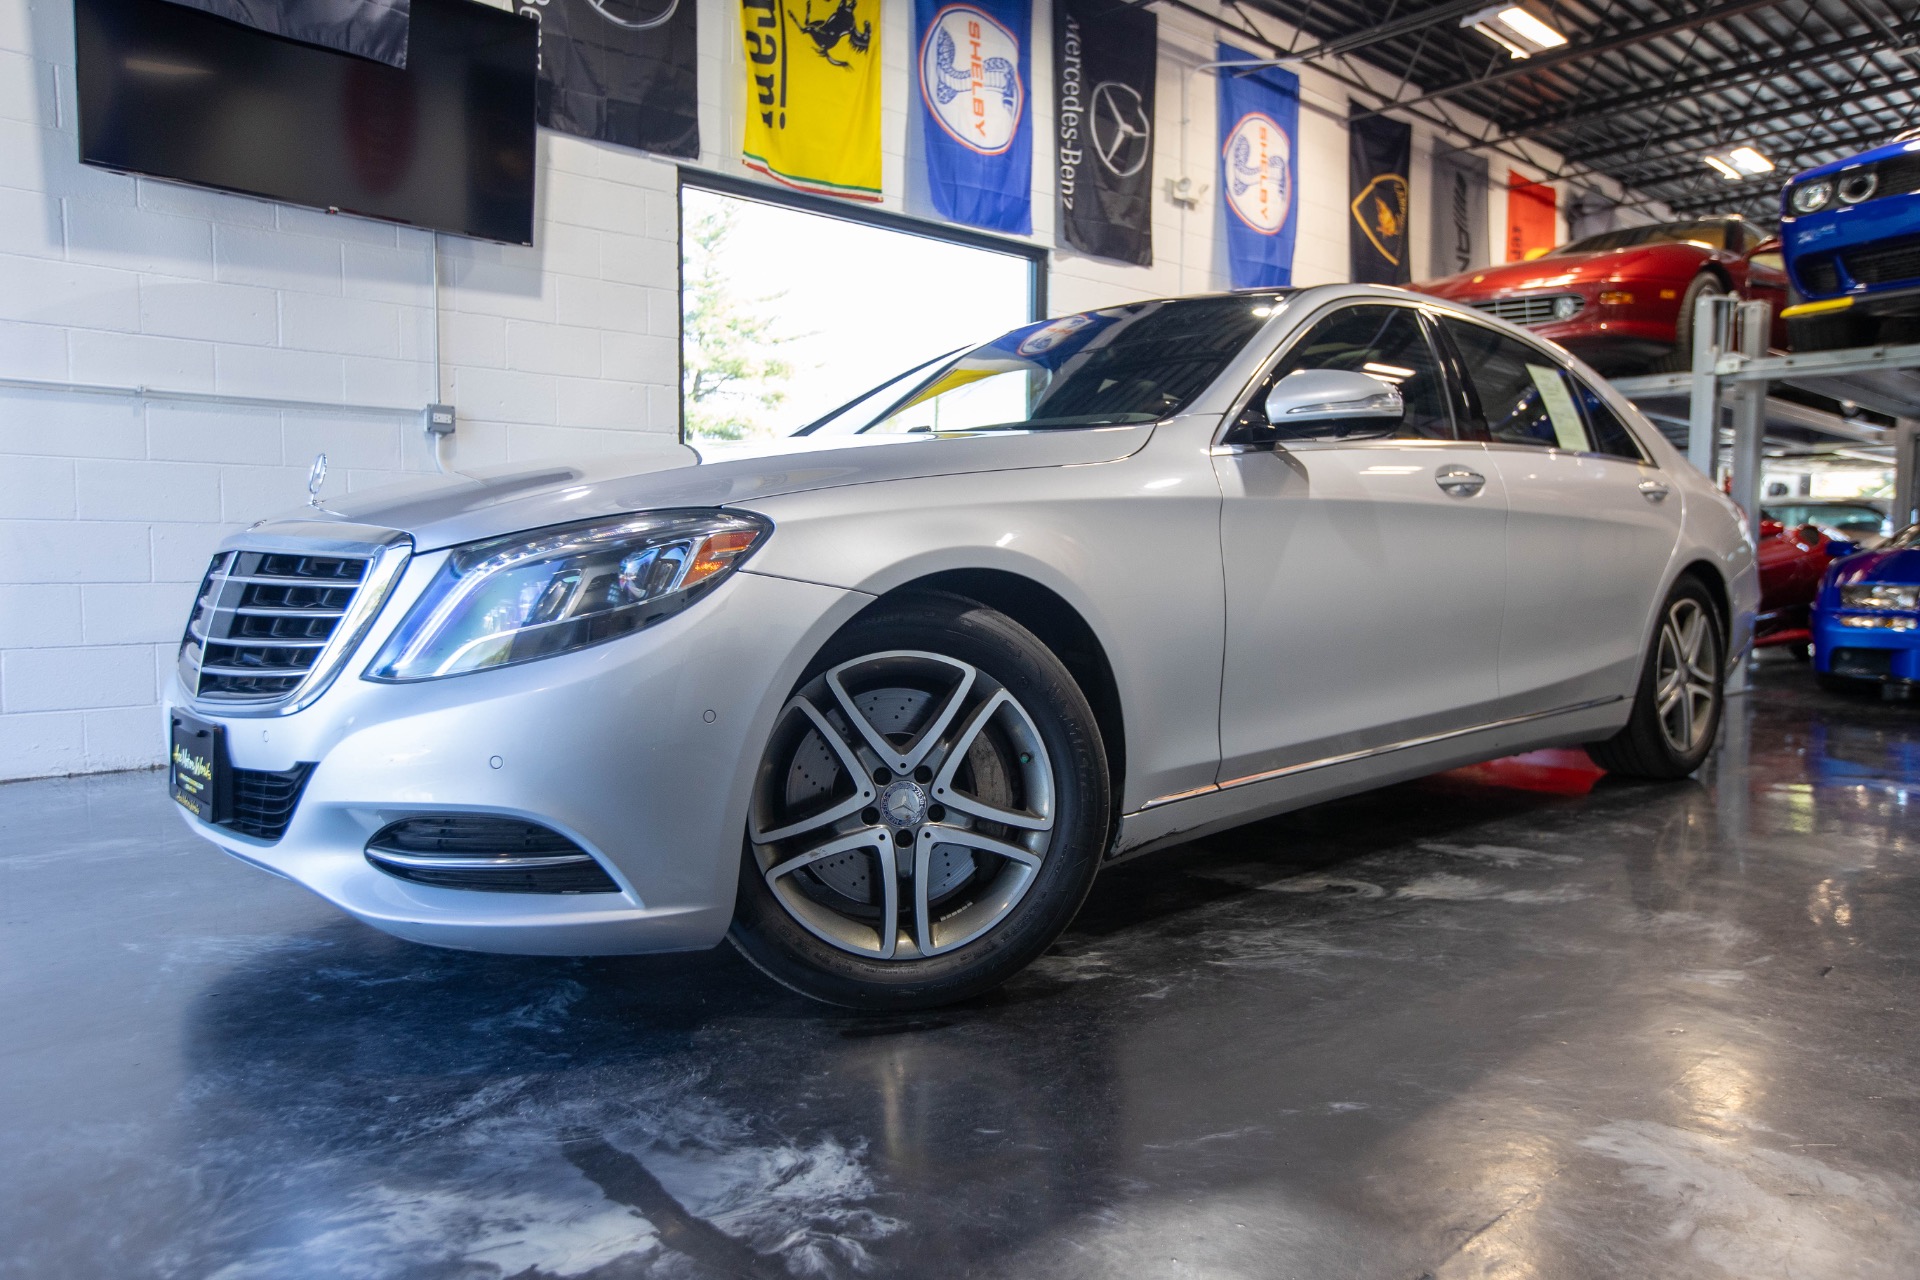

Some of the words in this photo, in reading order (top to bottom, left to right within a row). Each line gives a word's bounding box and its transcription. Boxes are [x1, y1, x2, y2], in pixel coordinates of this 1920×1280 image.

[968, 20, 986, 137] SHELBY
[1060, 14, 1084, 211] Mercedes-Benz
[1260, 126, 1268, 220] SHELBY
